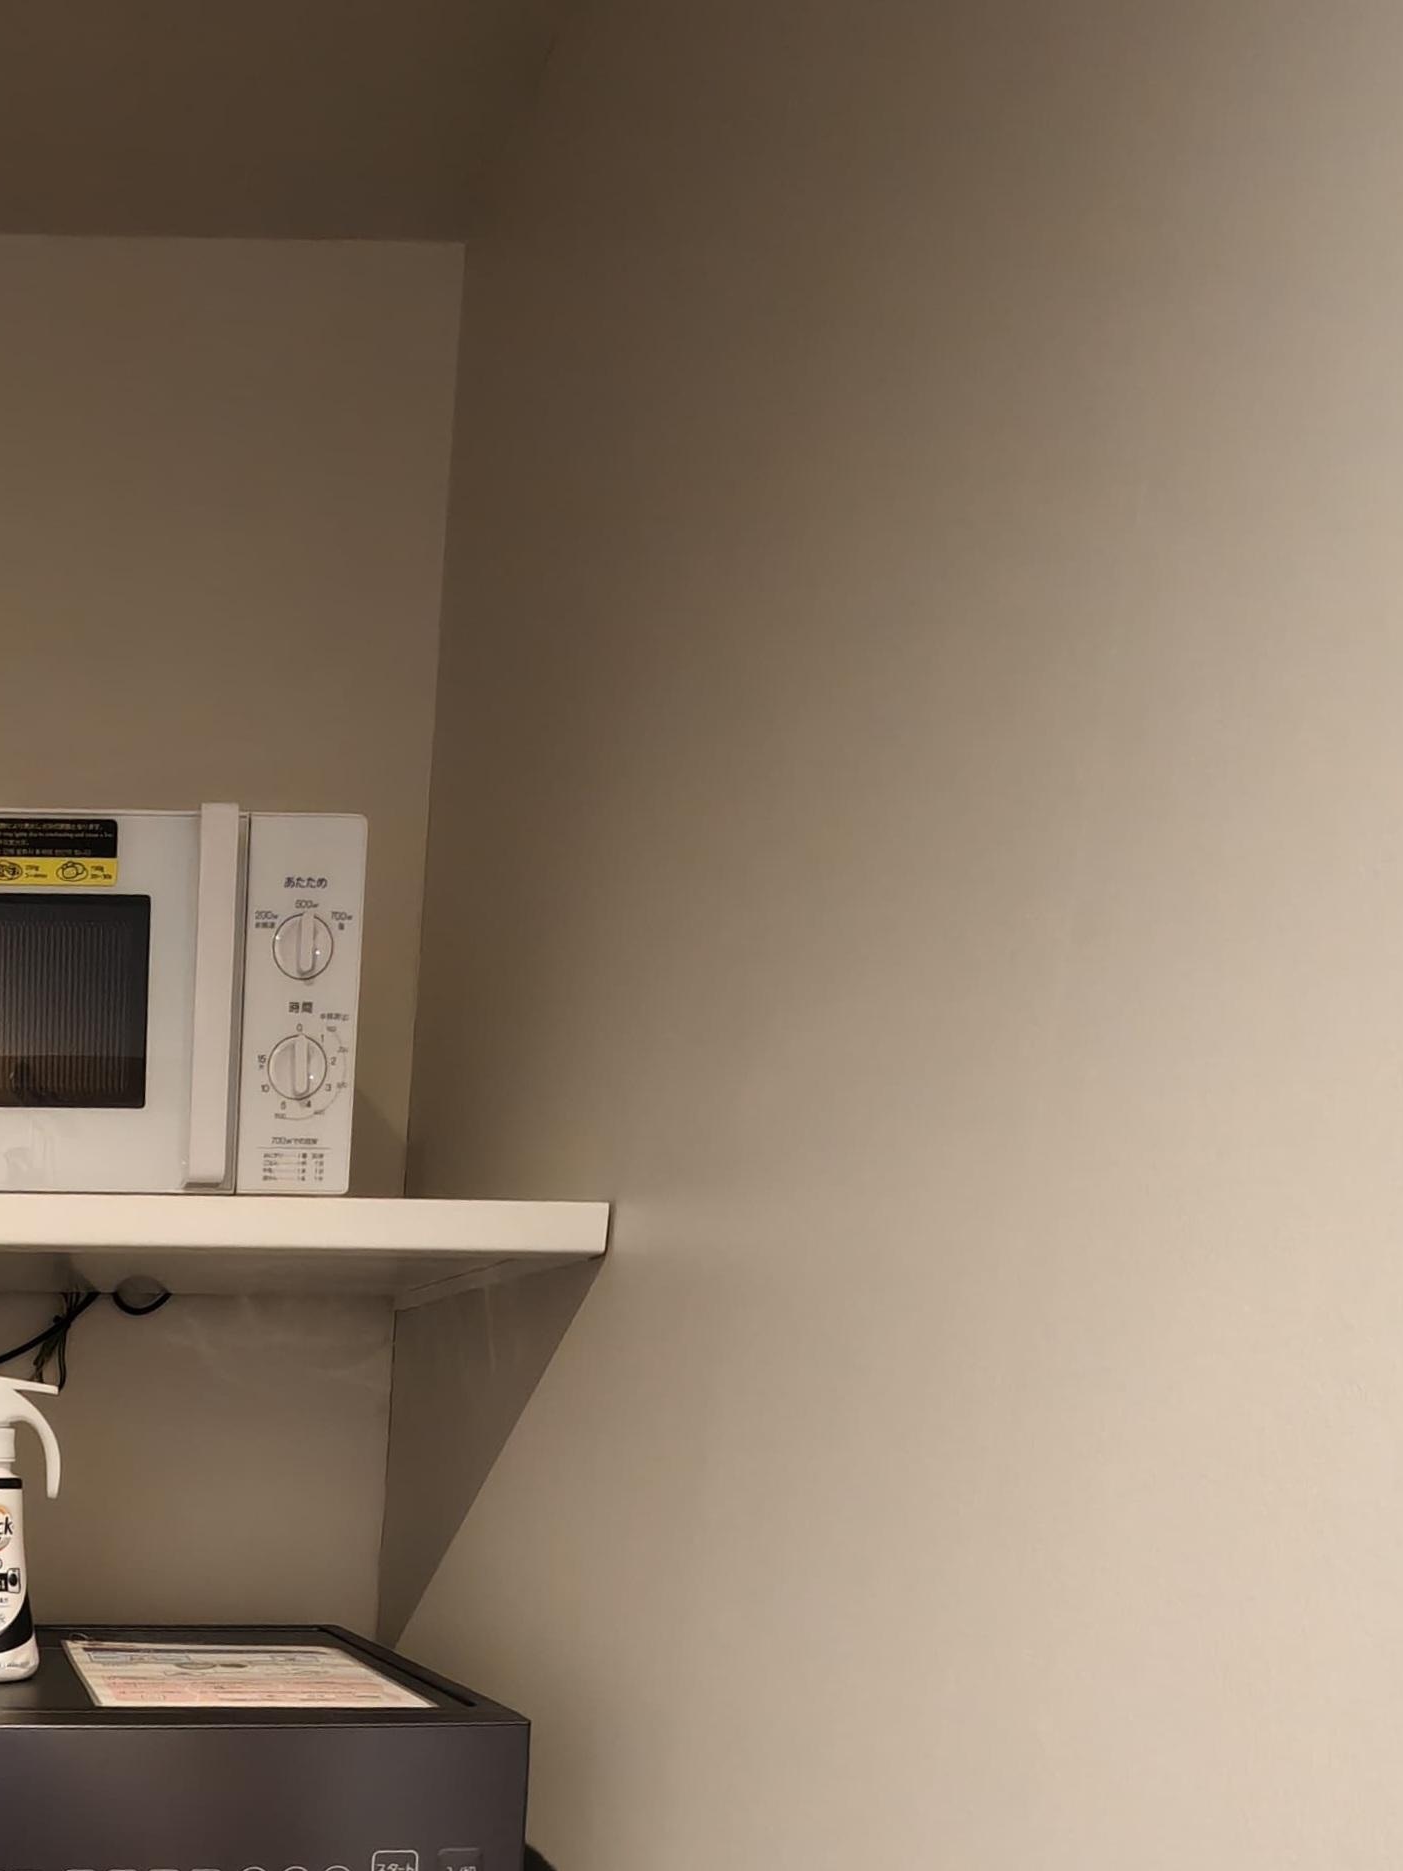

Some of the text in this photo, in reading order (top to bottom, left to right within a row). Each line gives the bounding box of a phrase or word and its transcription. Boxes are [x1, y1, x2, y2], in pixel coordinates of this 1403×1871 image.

[283, 876, 328, 888] あたため
[288, 1001, 313, 1014] 時間
[296, 1023, 303, 1032] 0
[257, 1054, 266, 1064] 15
[330, 1056, 337, 1066] 2
[261, 1083, 270, 1093] 10
